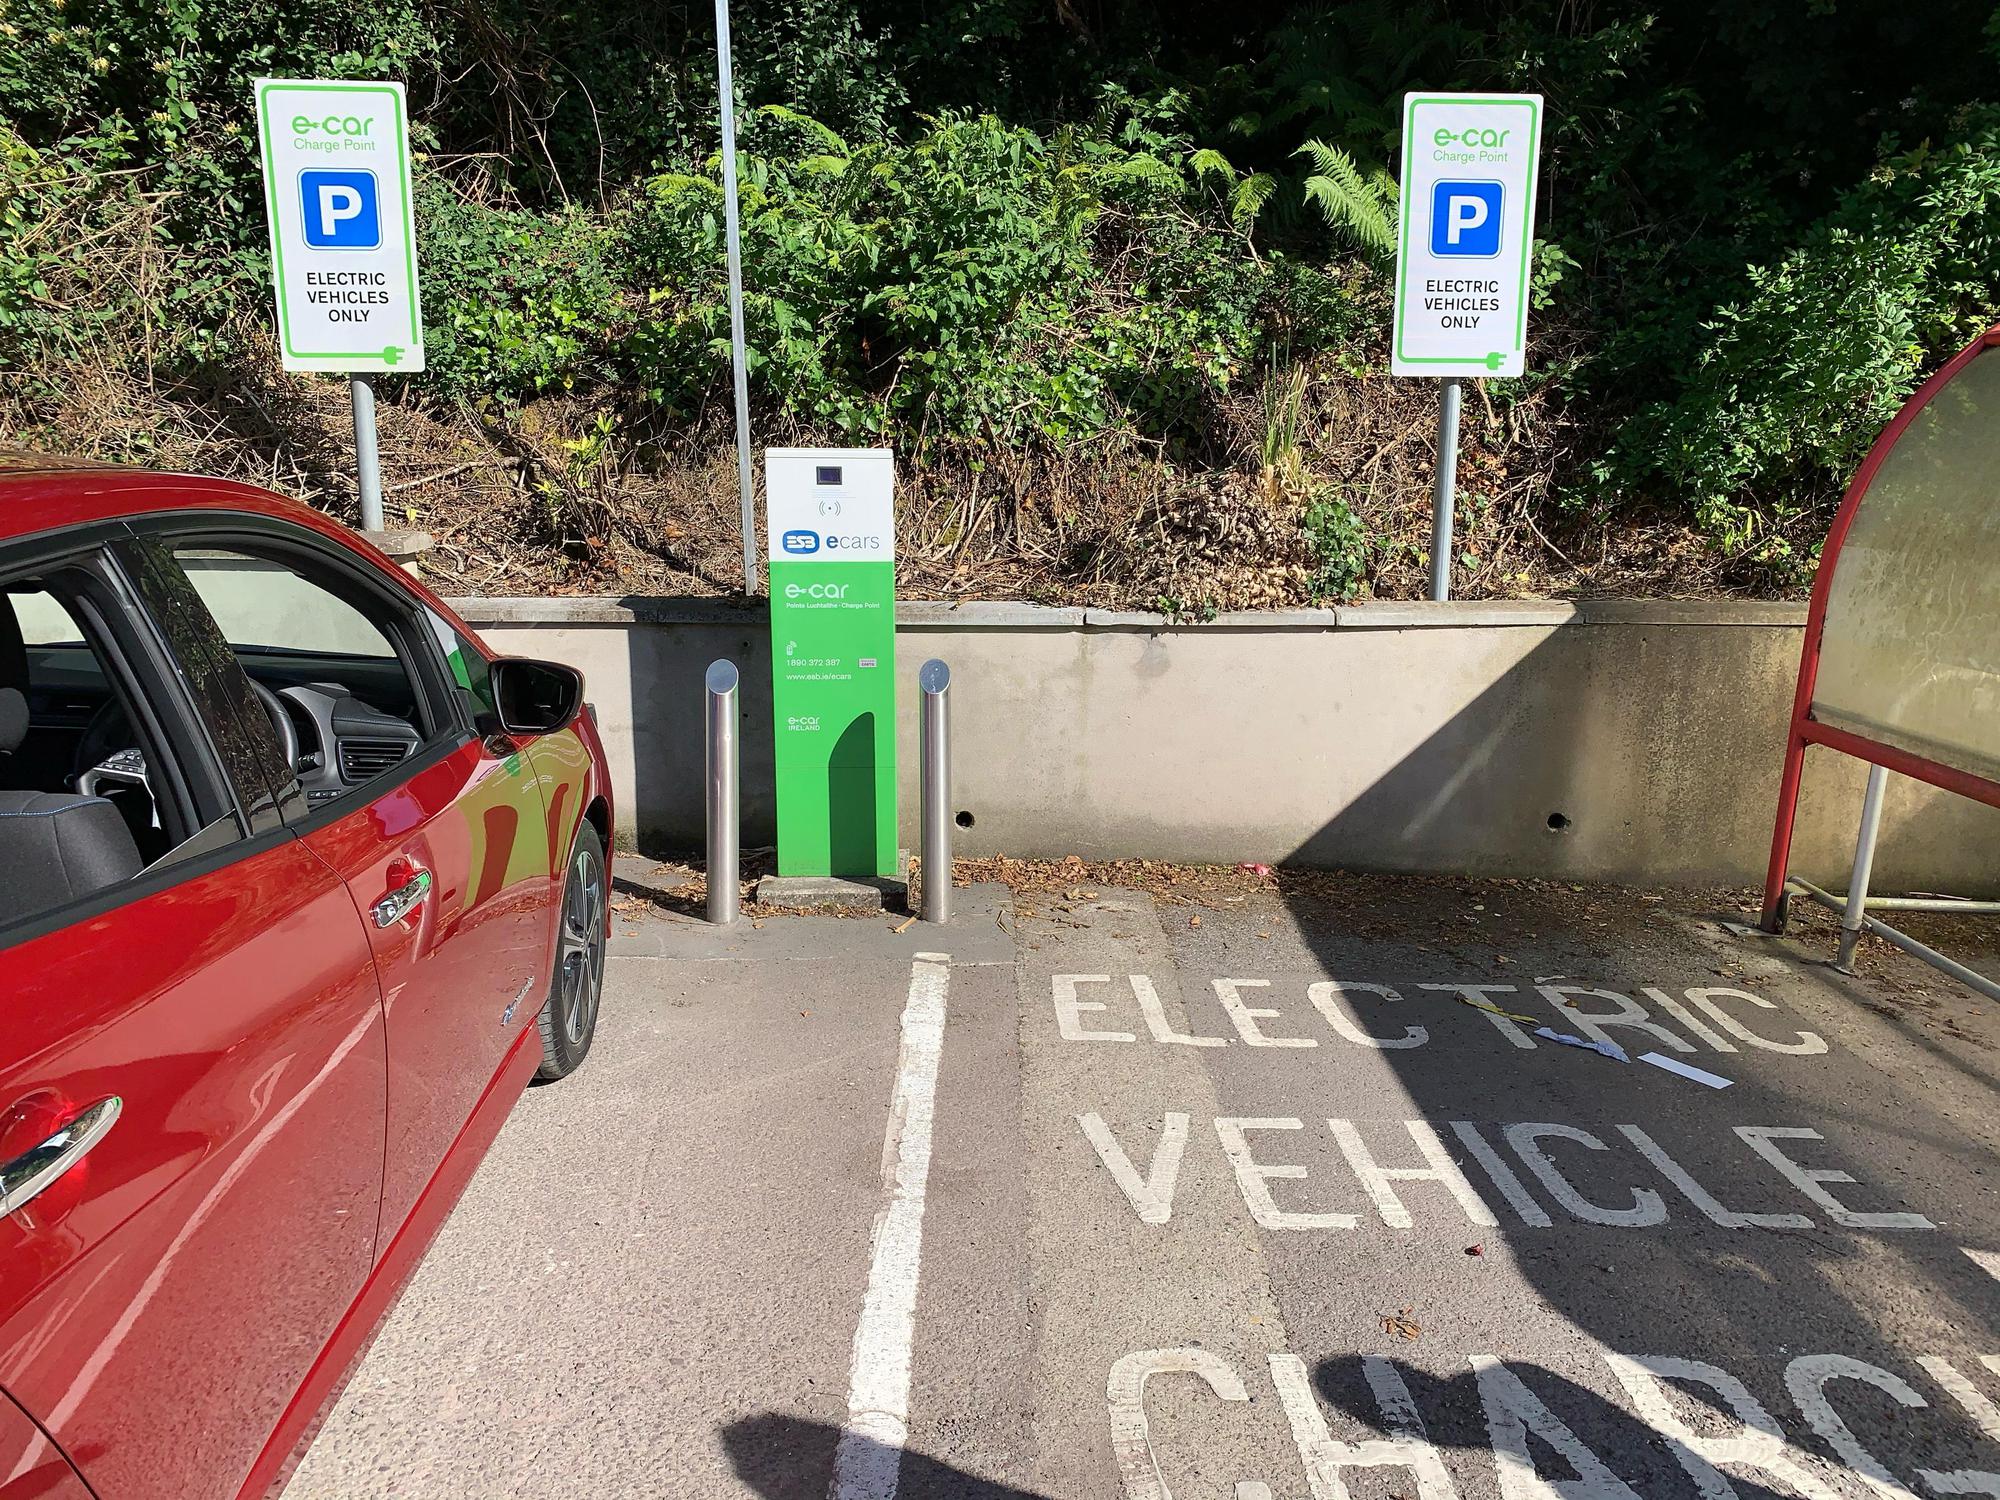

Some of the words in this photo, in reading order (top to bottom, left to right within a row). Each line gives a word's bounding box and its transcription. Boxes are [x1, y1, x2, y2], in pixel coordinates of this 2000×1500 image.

[293, 138, 340, 153] Charge
[344, 139, 376, 151] Point
[1432, 150, 1475, 164] Charge
[1479, 150, 1508, 162] Point
[318, 185, 363, 236] P
[1447, 195, 1488, 245] P
[306, 272, 386, 286] ELECTRIC
[1425, 279, 1499, 294] ELECTRIC
[306, 290, 389, 304] VEHICLES
[1424, 298, 1500, 311] VEHICLES
[328, 309, 371, 322] ONLY
[1440, 315, 1480, 329] ONLY
[785, 533, 817, 551] ESB
[826, 534, 880, 550] ecars
[841, 602, 863, 610] Charge
[787, 659, 807, 667] 1890
[809, 659, 824, 667] 372
[825, 659, 841, 667] 387
[1052, 974, 1828, 1055] ELECTRIC
[1078, 1111, 1937, 1230] VEHICLE
